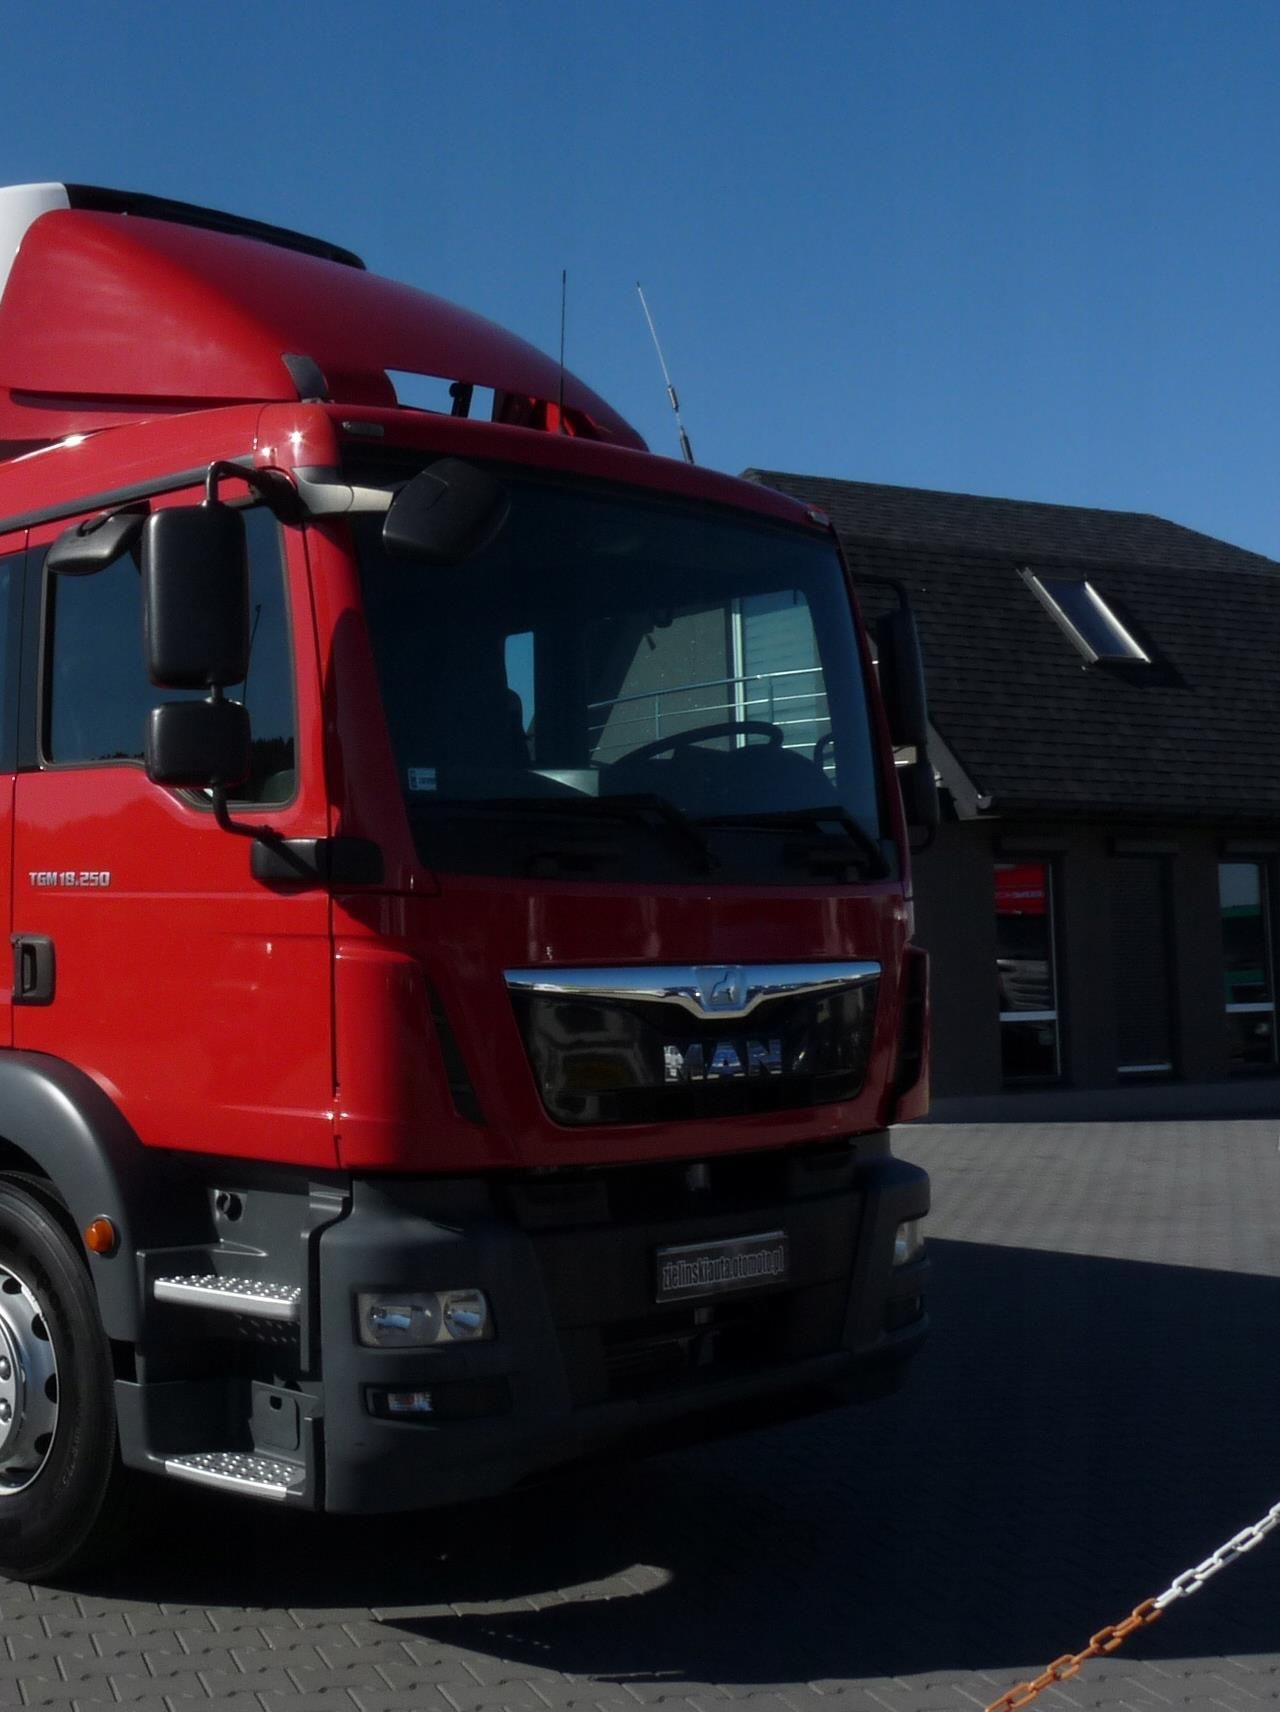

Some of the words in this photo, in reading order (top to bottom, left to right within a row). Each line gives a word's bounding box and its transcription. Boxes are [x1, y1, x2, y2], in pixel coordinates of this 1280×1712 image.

[29, 871, 58, 886] TGM
[59, 871, 110, 886] 18.250
[663, 1039, 782, 1082] MAN
